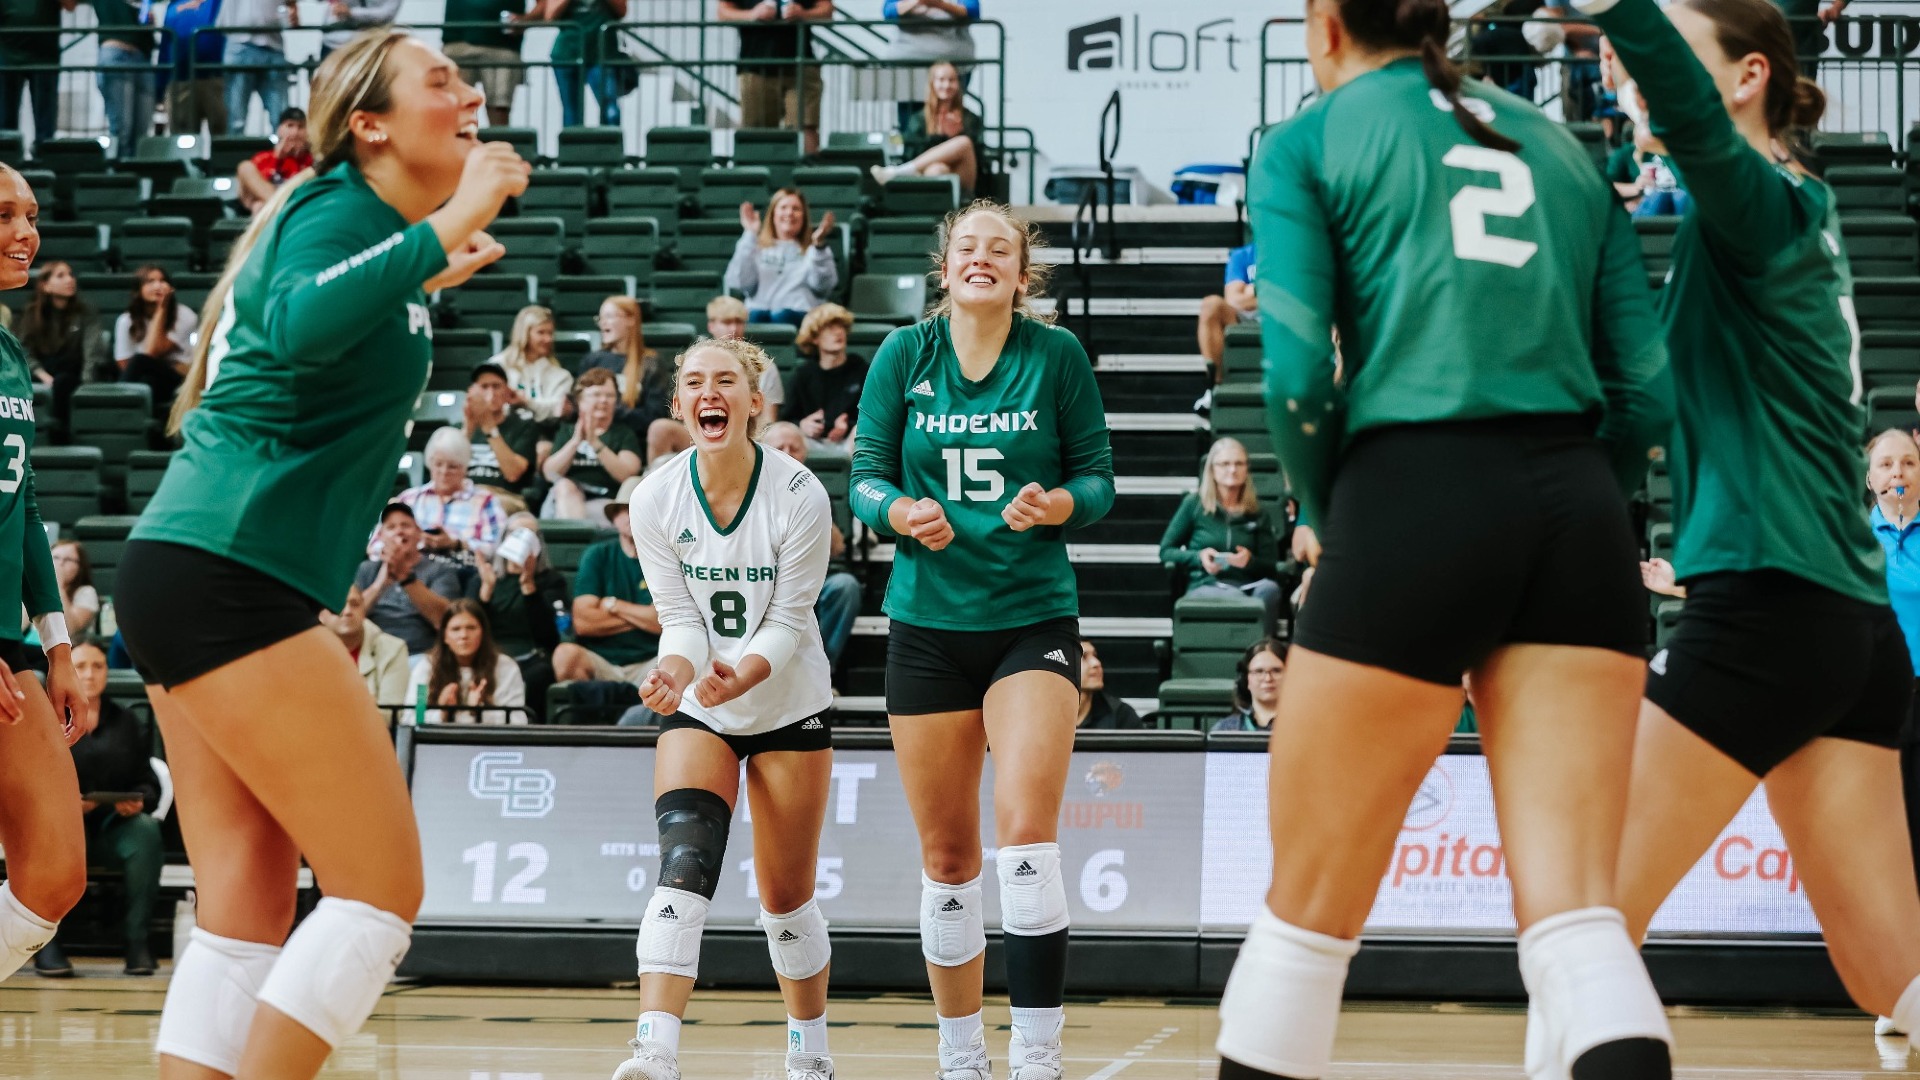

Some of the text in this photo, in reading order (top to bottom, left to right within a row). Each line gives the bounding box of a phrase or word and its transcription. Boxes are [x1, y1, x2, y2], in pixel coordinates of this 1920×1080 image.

[1067, 13, 1240, 72] aloft
[1441, 144, 1539, 268] 2
[915, 410, 1039, 434] PHOENIX
[941, 447, 1005, 502] 15
[710, 590, 747, 639] 8
[1062, 803, 1144, 829] IUPUI
[462, 841, 550, 904] 12
[601, 842, 636, 856] SETS
[1014, 867, 1037, 877] adidas
[627, 867, 647, 892] 0
[1079, 850, 1129, 913] 6
